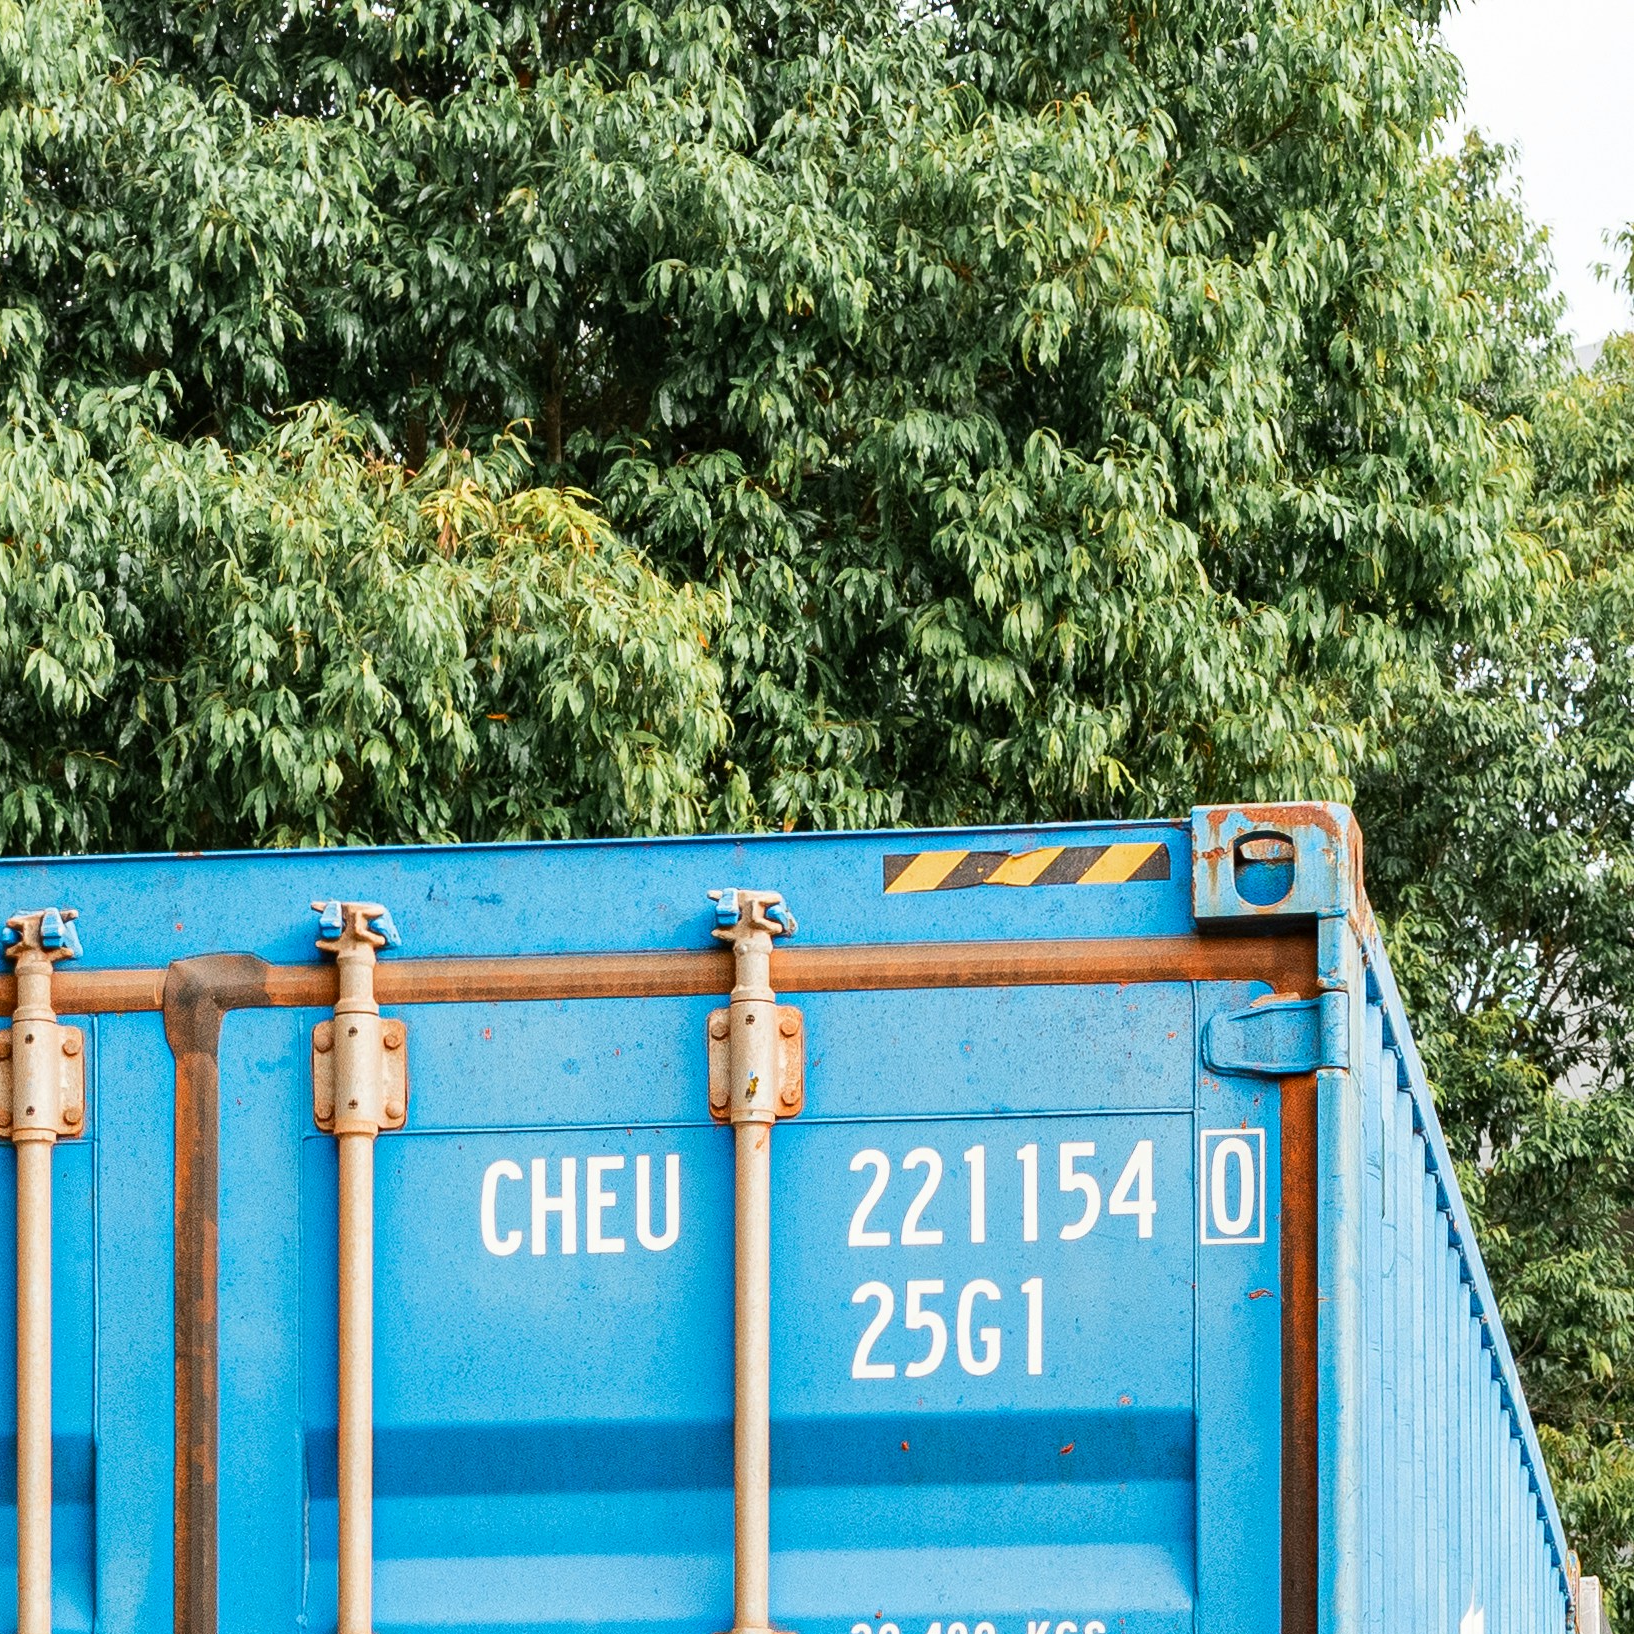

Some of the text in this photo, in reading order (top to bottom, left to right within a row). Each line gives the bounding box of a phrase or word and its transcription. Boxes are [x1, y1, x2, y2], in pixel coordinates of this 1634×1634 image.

[480, 1154, 680, 1257] CHEU
[847, 1137, 1256, 1247] 221154 0
[851, 1277, 1043, 1379] 25G1
